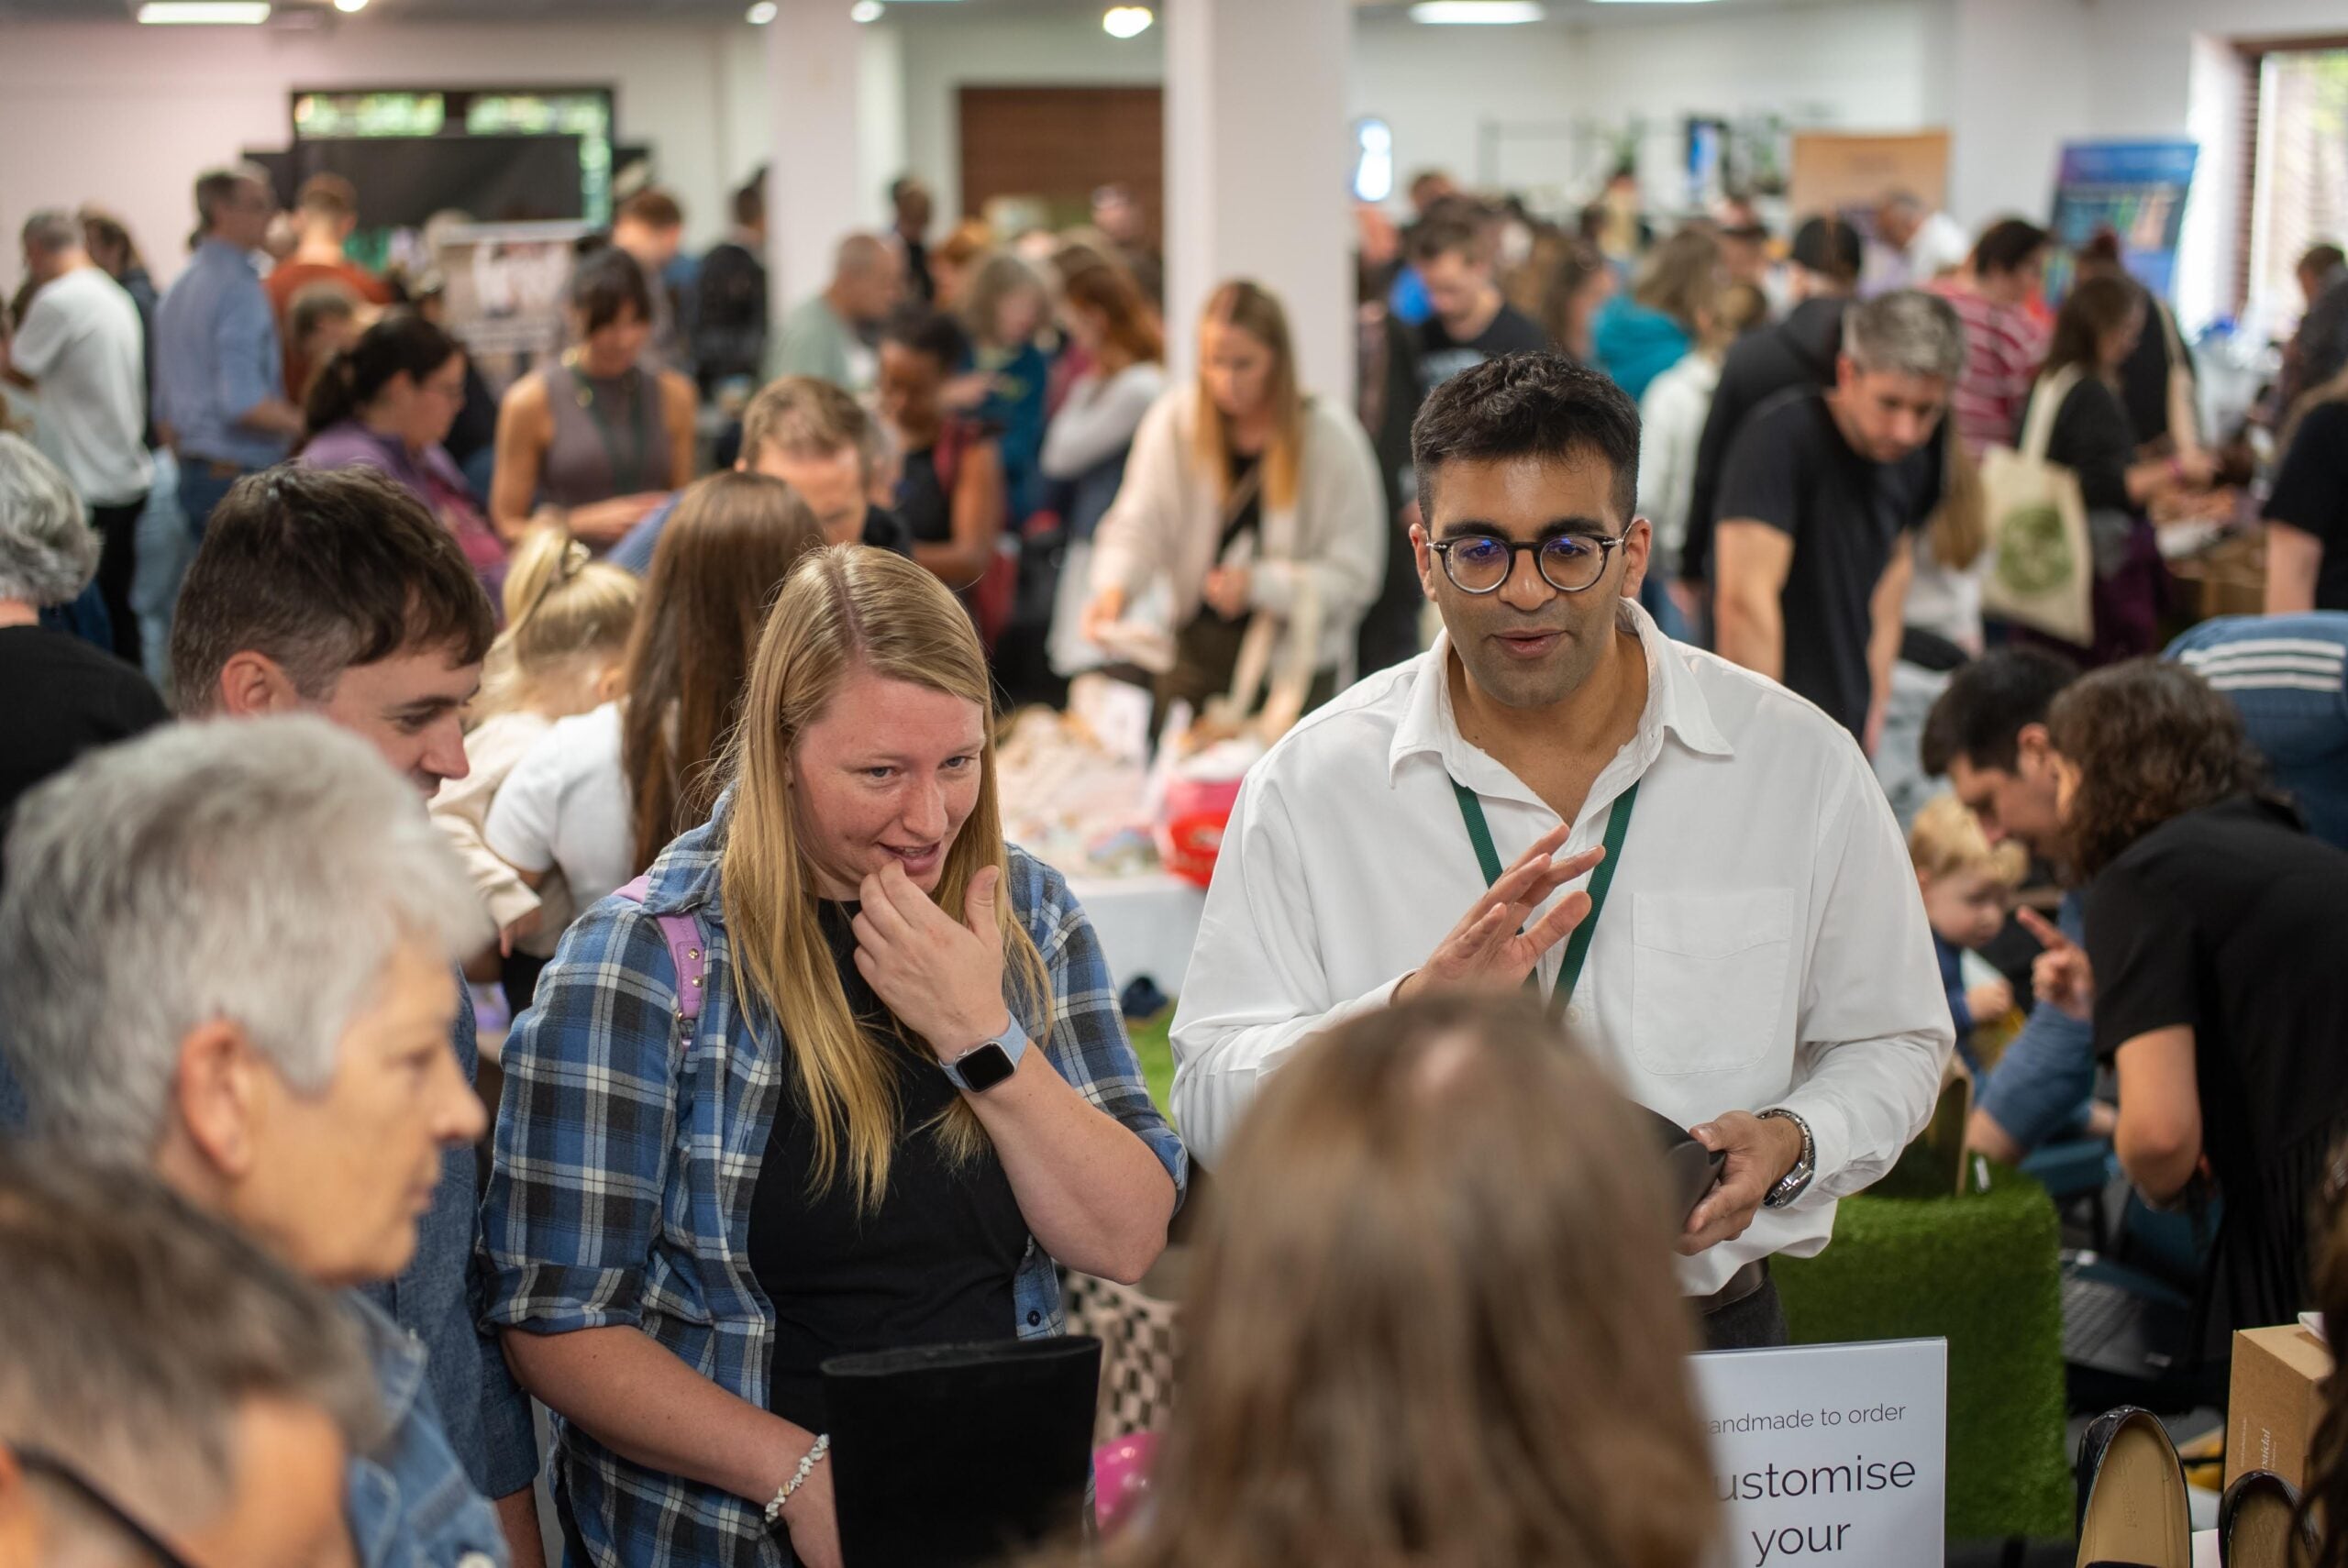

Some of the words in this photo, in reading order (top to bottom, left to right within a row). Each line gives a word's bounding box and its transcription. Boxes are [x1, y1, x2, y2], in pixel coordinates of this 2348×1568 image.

[1708, 1409, 1814, 1435] andmade
[1821, 1408, 1842, 1426] to
[1848, 1403, 1907, 1424] order
[1713, 1454, 1916, 1502] ustomise
[1751, 1523, 1852, 1568] your
